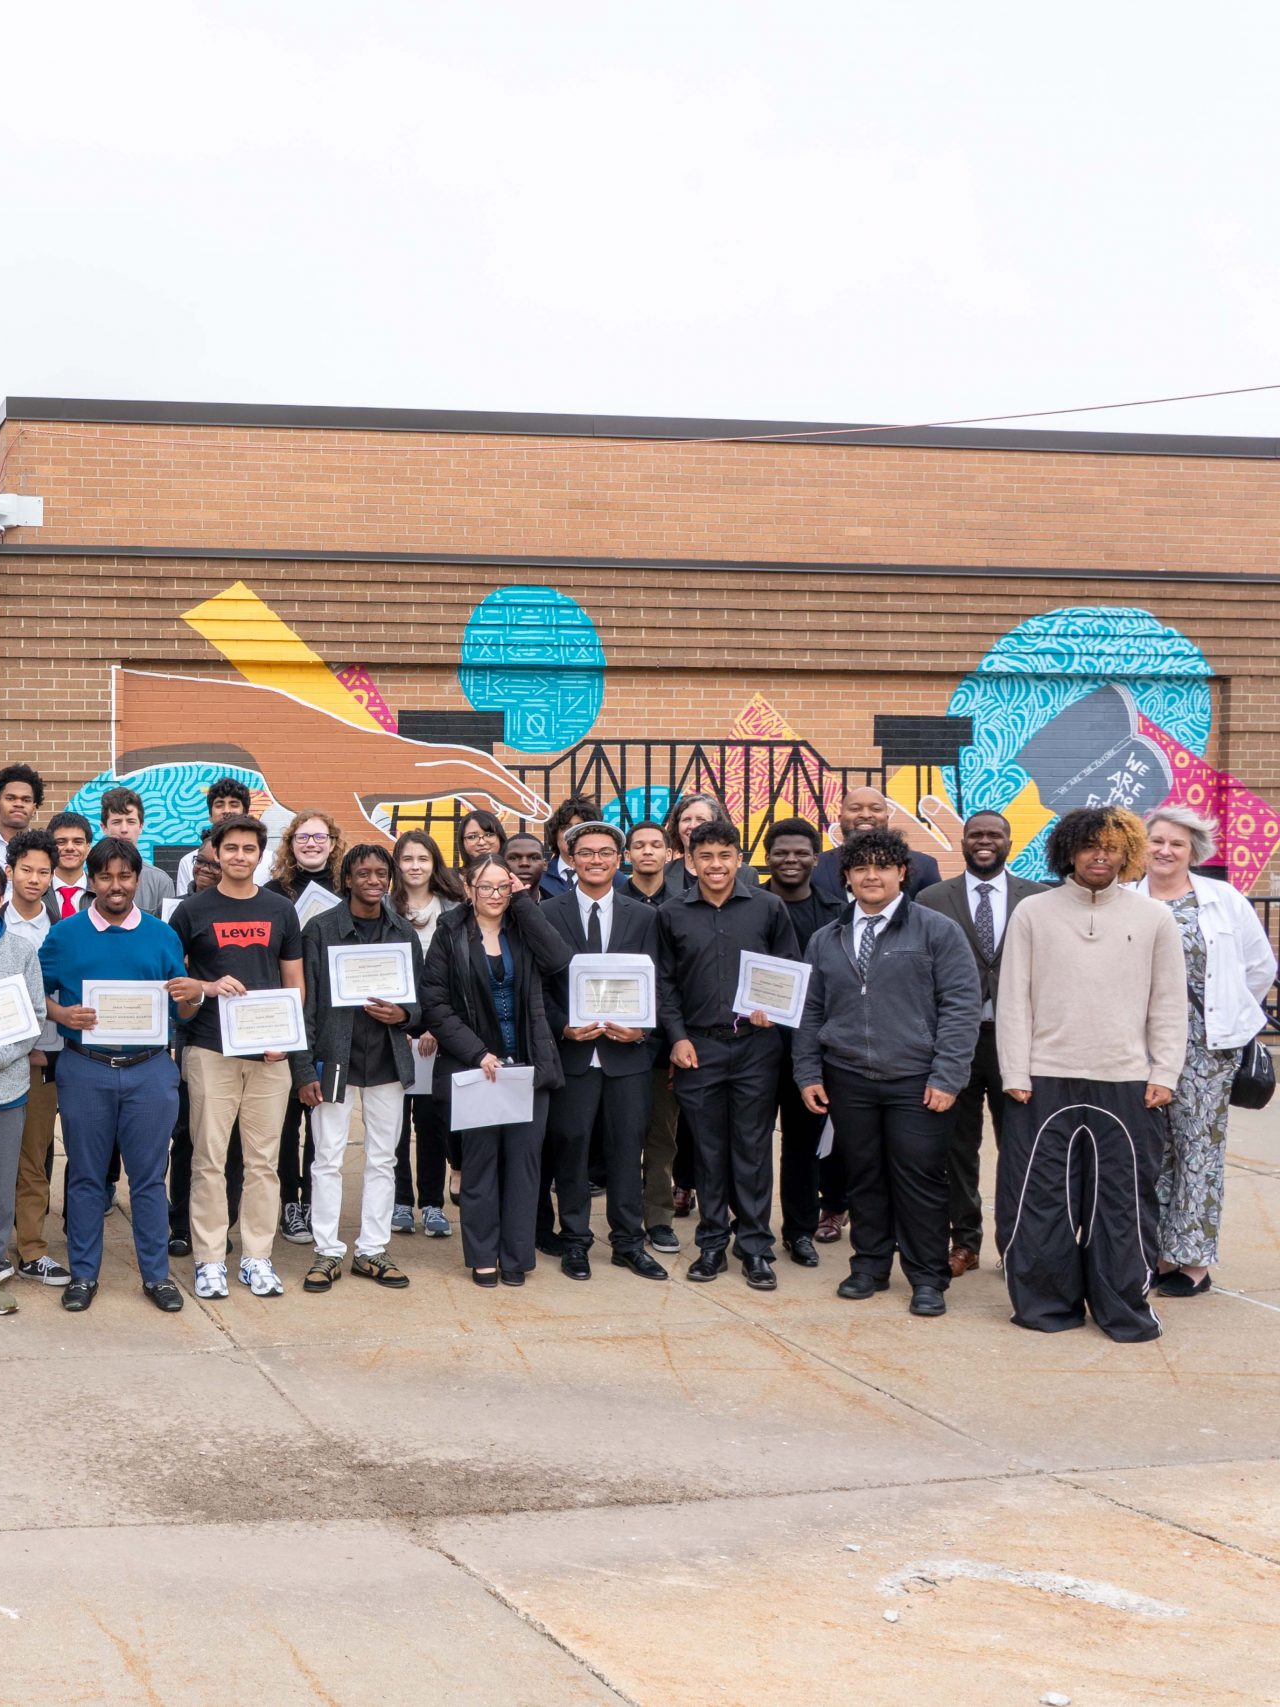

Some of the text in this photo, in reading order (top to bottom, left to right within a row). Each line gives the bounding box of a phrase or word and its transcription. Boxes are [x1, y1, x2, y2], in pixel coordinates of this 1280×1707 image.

[1125, 751, 1150, 777] WE
[1106, 770, 1146, 798] ARE
[1102, 787, 1134, 810] the
